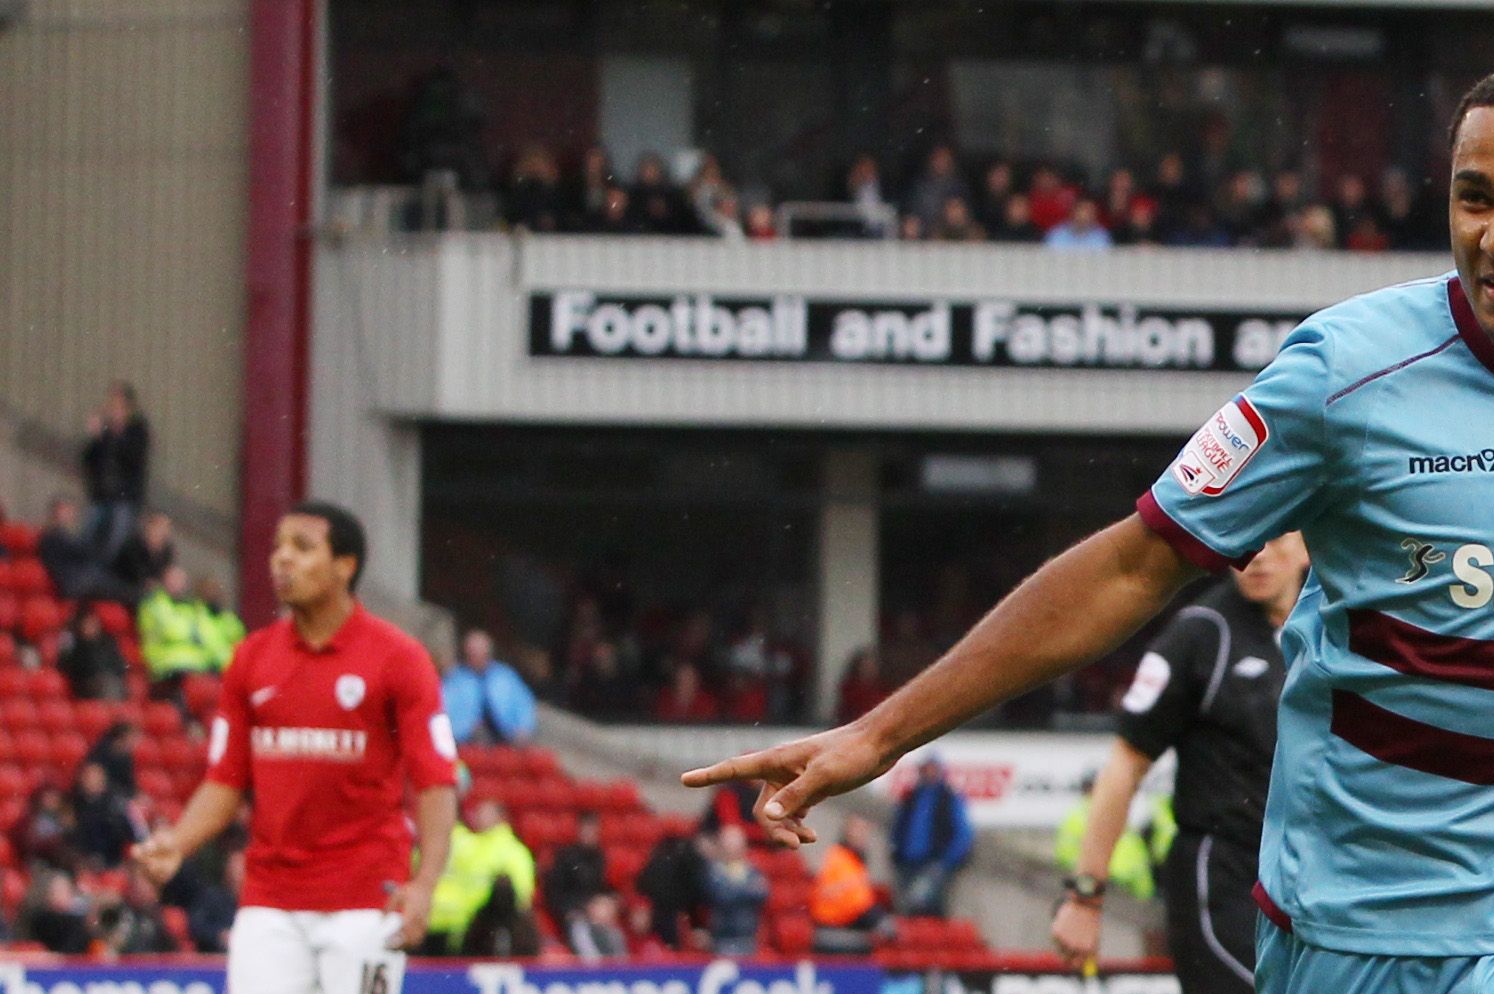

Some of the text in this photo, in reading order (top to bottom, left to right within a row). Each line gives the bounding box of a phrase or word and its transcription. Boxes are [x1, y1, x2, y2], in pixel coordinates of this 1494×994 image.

[548, 292, 808, 356] Football
[831, 304, 952, 362] and
[973, 303, 1216, 369] Fashion
